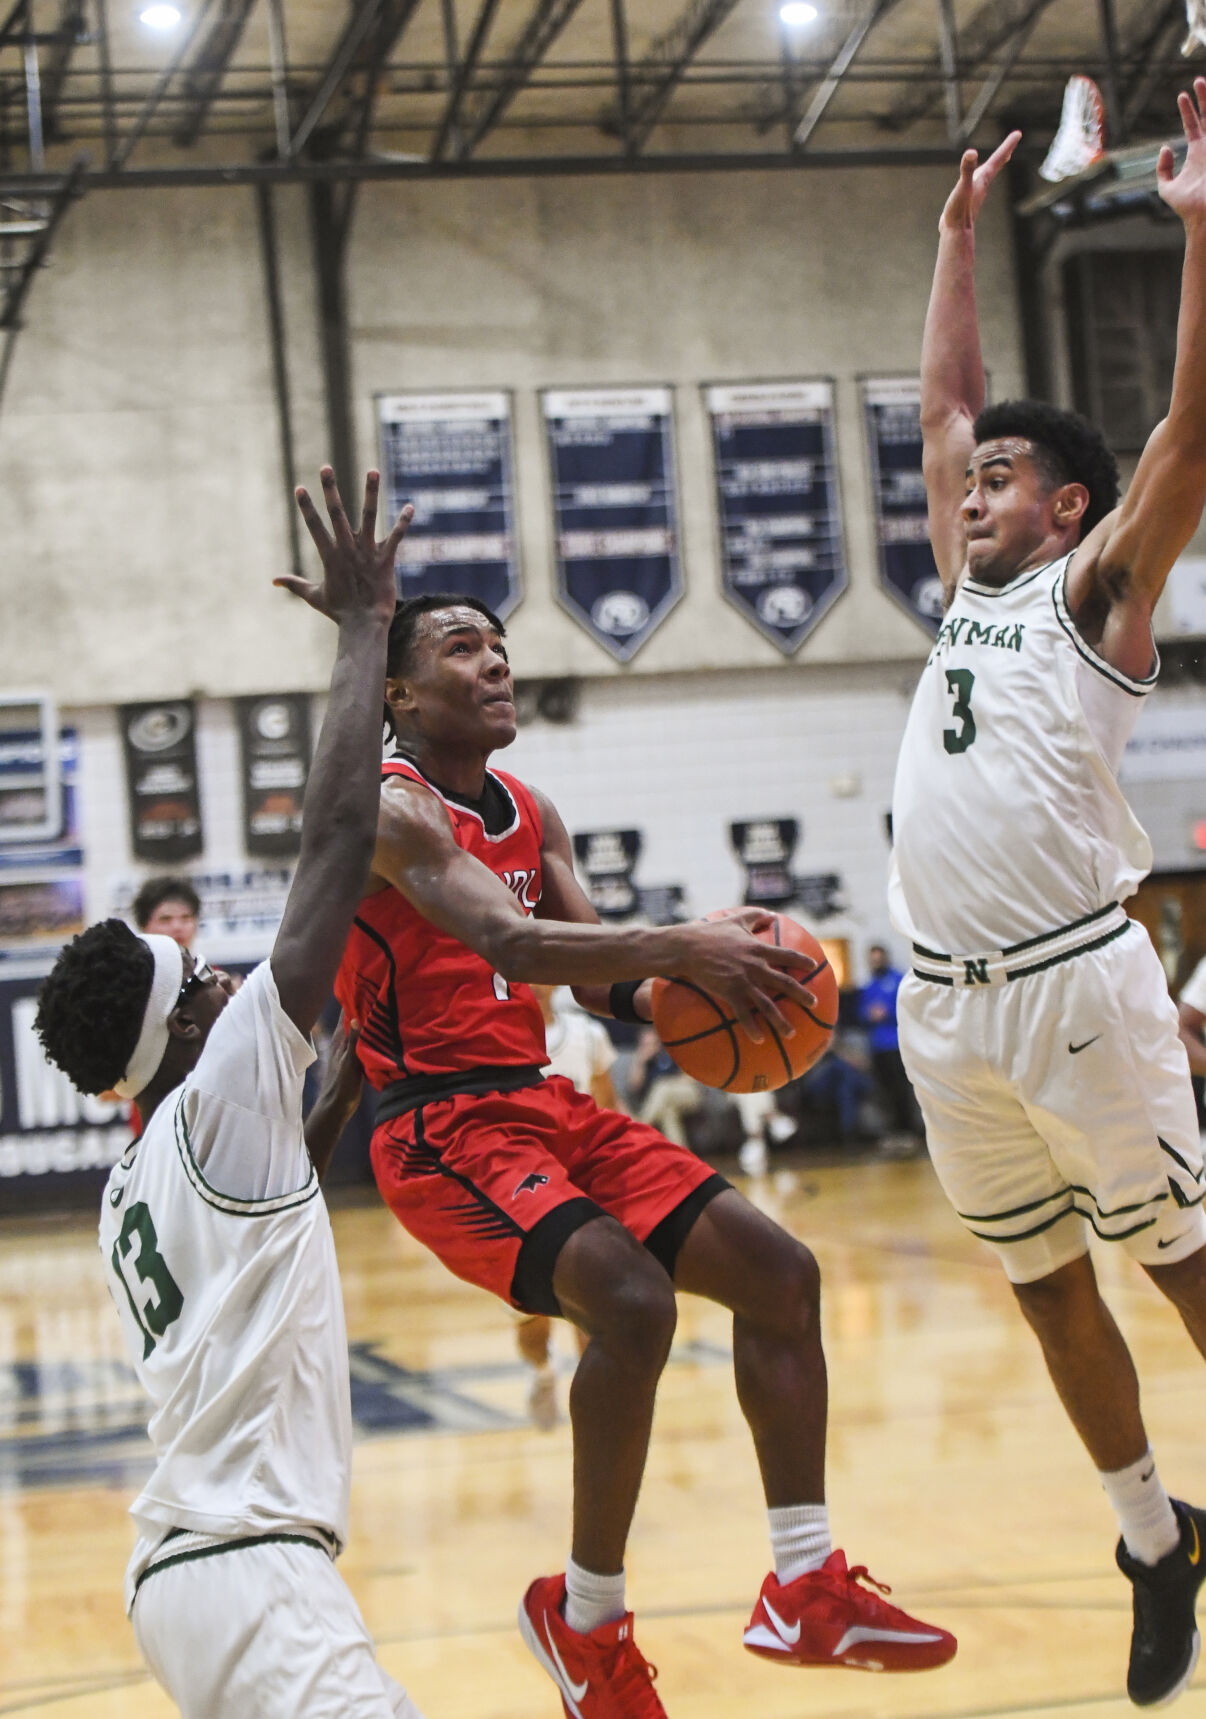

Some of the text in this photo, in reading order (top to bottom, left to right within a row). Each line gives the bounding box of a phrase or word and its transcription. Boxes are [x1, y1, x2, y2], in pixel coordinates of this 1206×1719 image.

[943, 668, 977, 756] 3
[962, 958, 992, 985] N
[111, 1201, 185, 1361] 13
